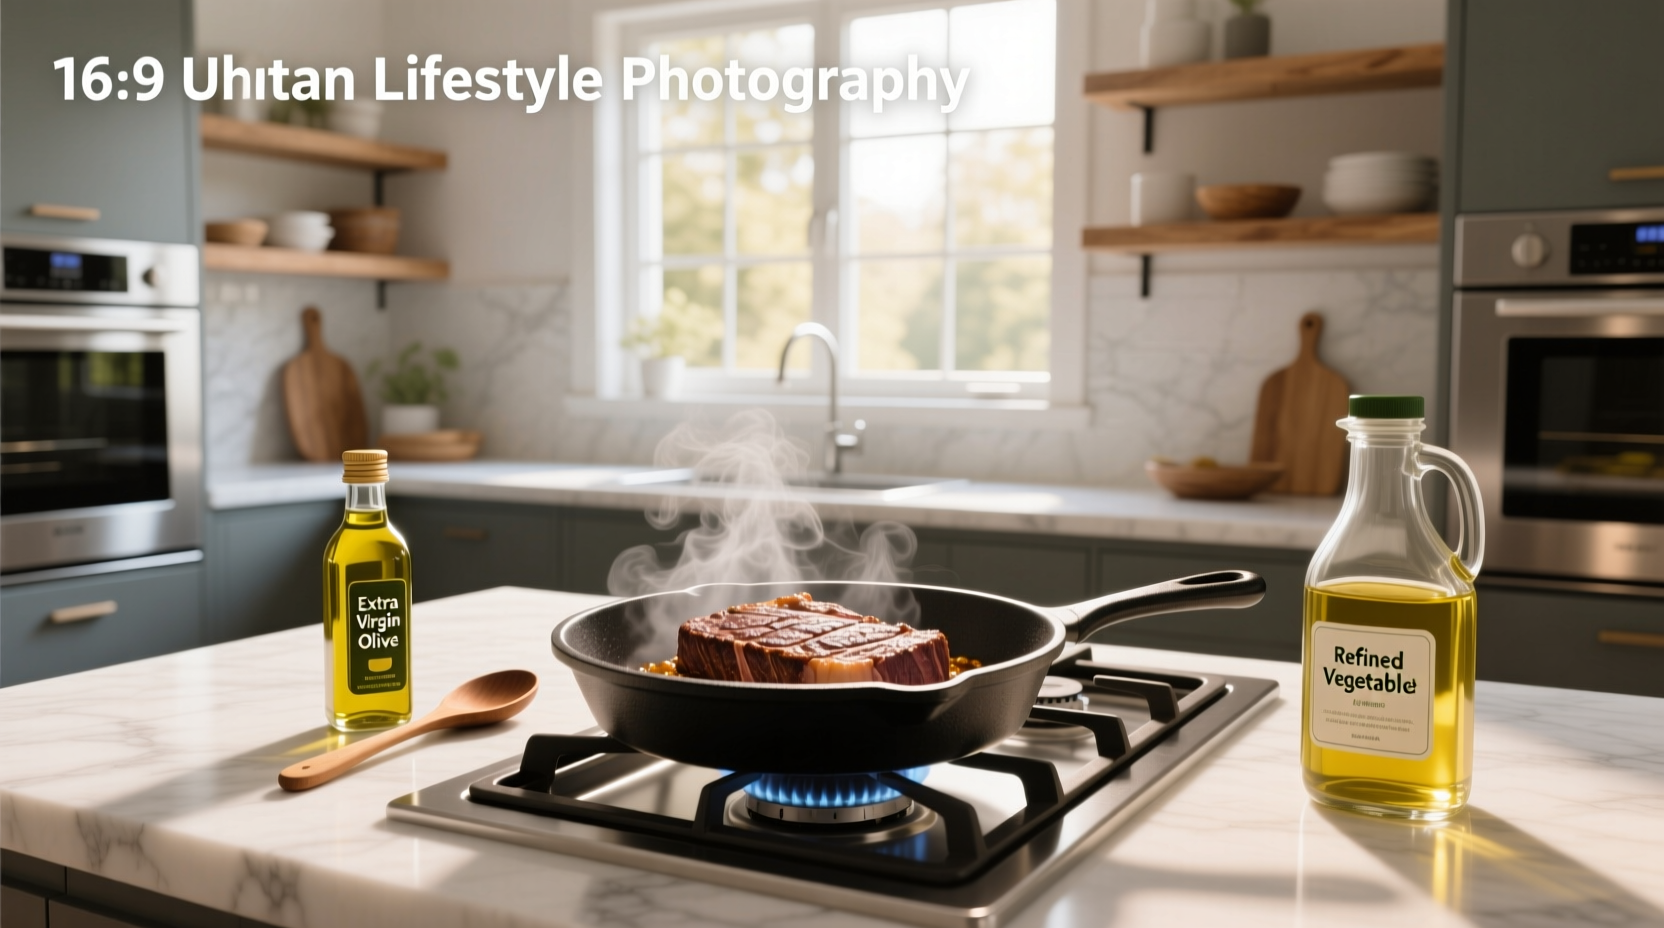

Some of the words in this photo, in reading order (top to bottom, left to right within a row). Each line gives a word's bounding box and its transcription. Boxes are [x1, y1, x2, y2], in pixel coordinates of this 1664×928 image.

[358, 596, 399, 611] Extra
[358, 632, 399, 649] Olive
[1334, 646, 1403, 669] Refined
